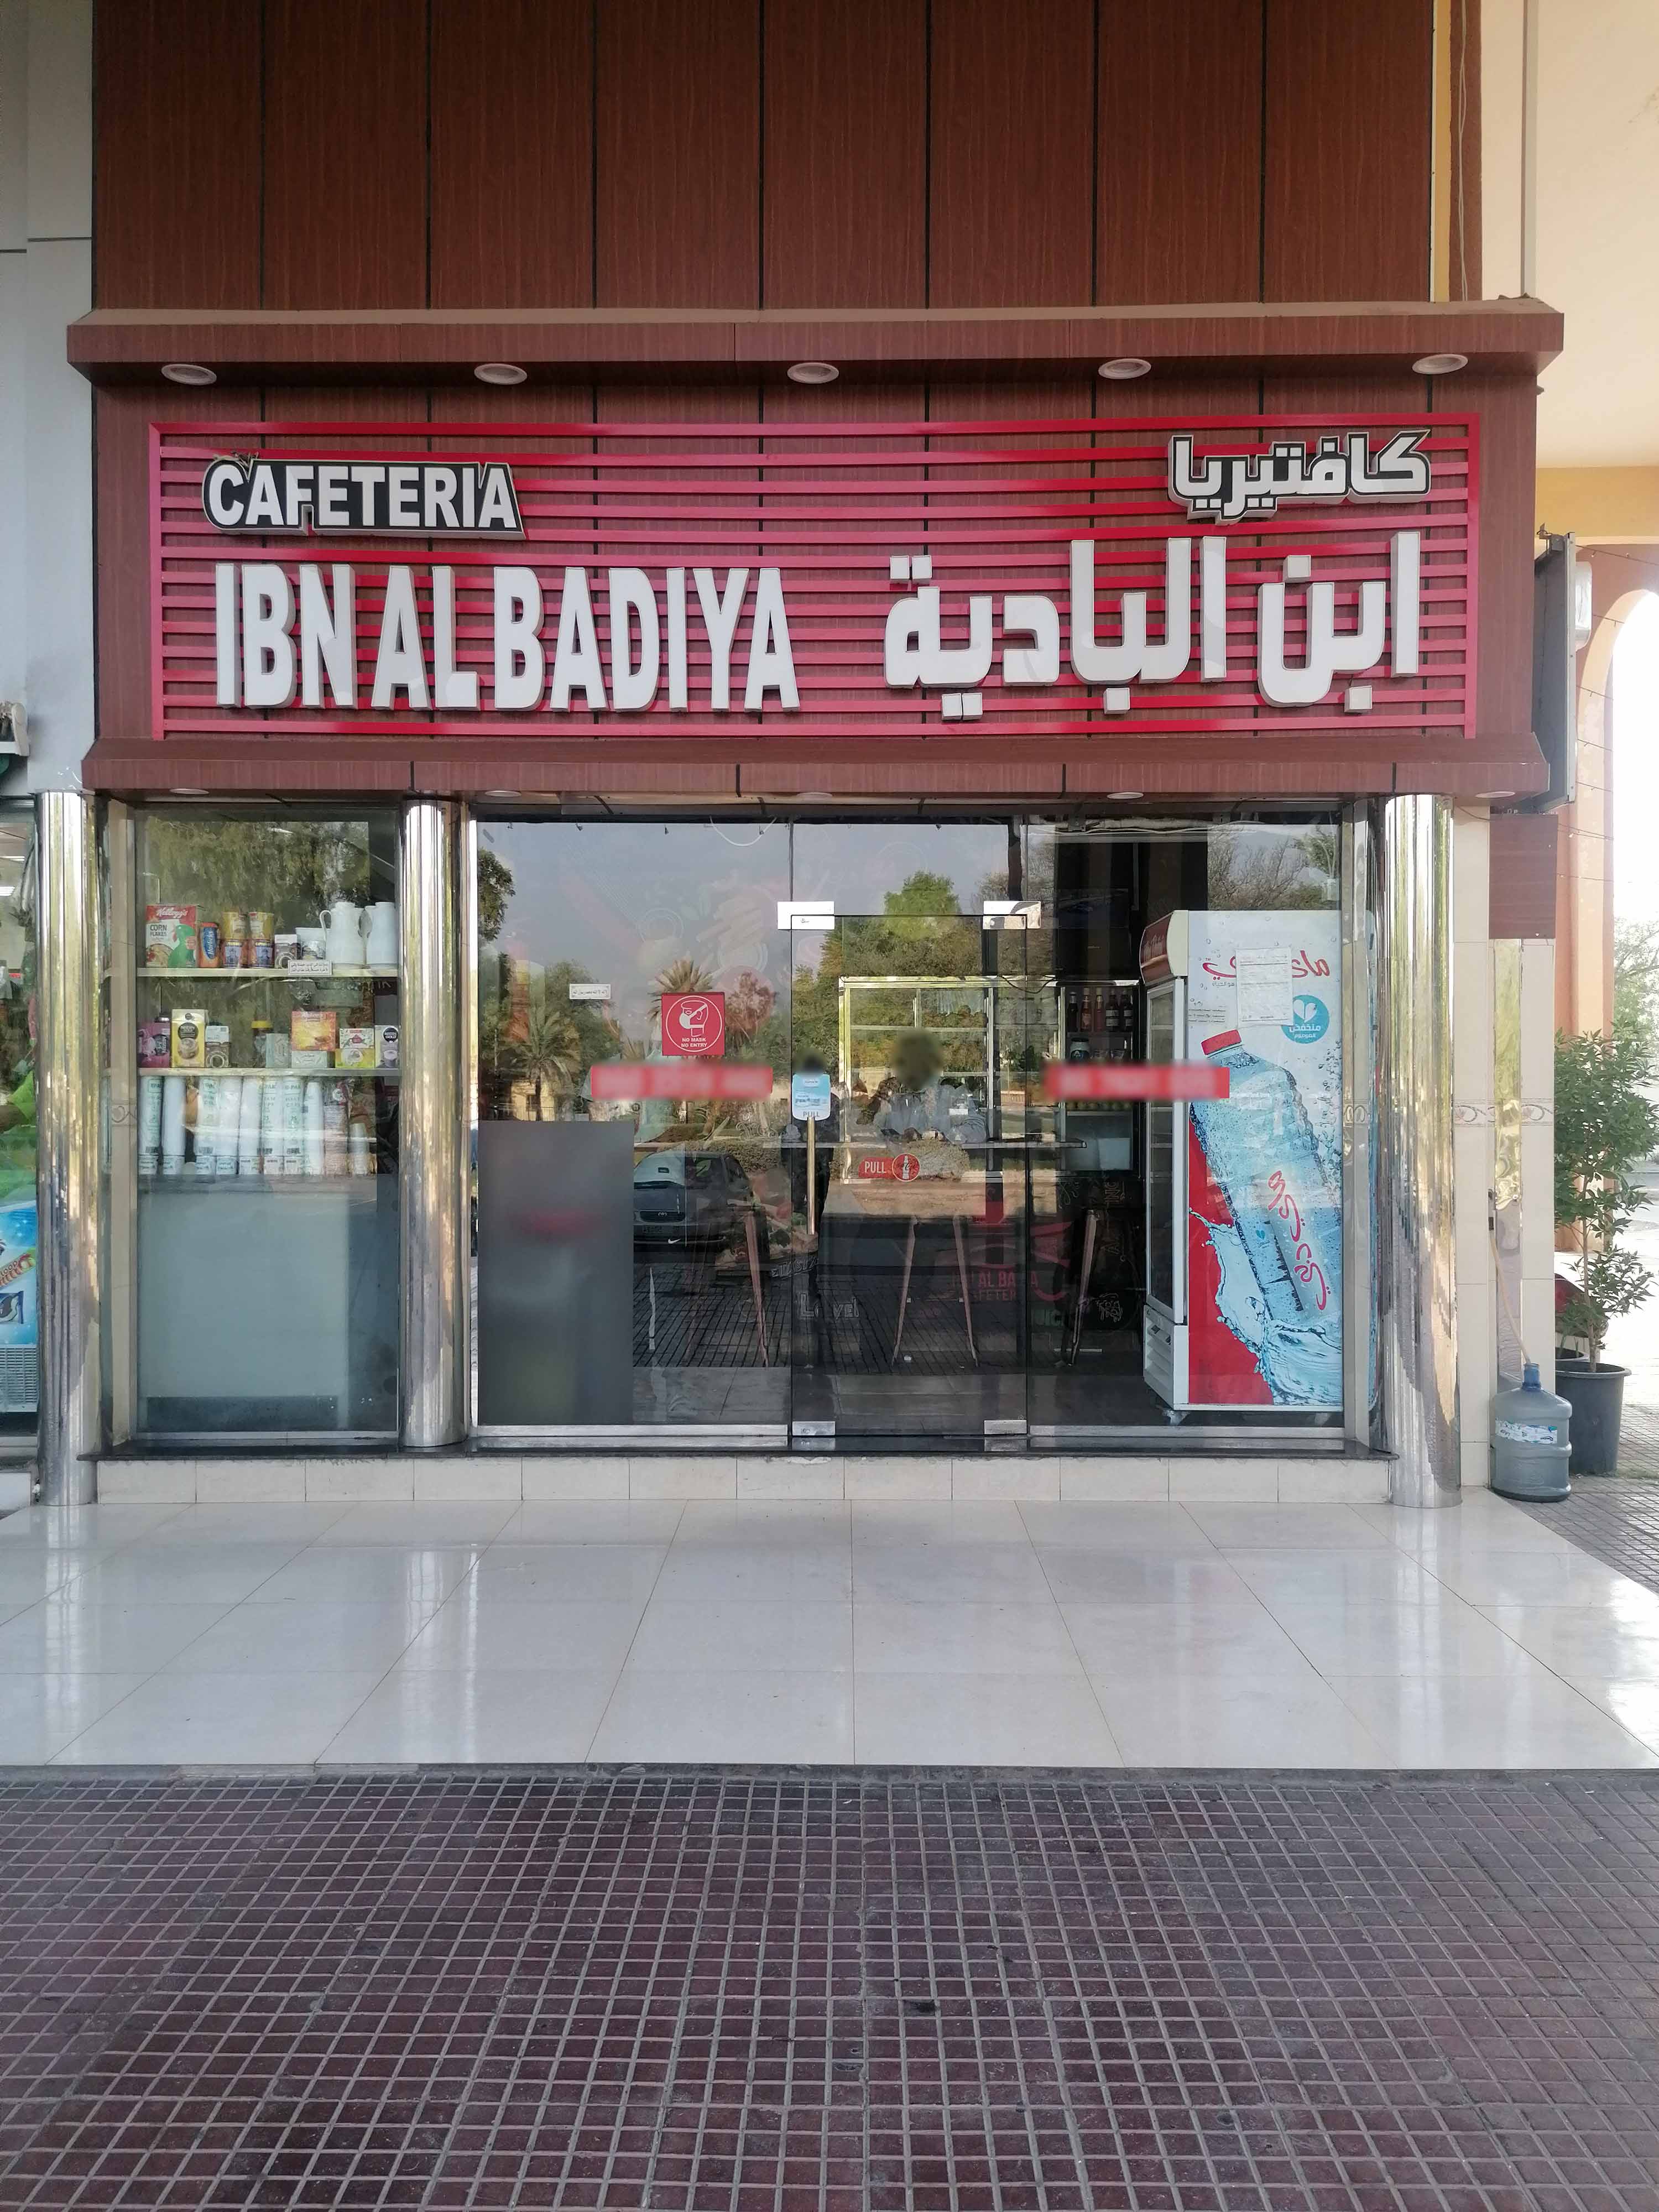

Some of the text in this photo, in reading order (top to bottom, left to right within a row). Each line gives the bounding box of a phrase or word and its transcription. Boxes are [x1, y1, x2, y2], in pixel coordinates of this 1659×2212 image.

[208, 464, 518, 529] CAFETERIA
[1172, 430, 1431, 521] كافتيريا
[216, 563, 801, 713] IBN AL BADIYA
[885, 531, 1421, 721] ابن البادية
[864, 1161, 886, 1173] PULL
